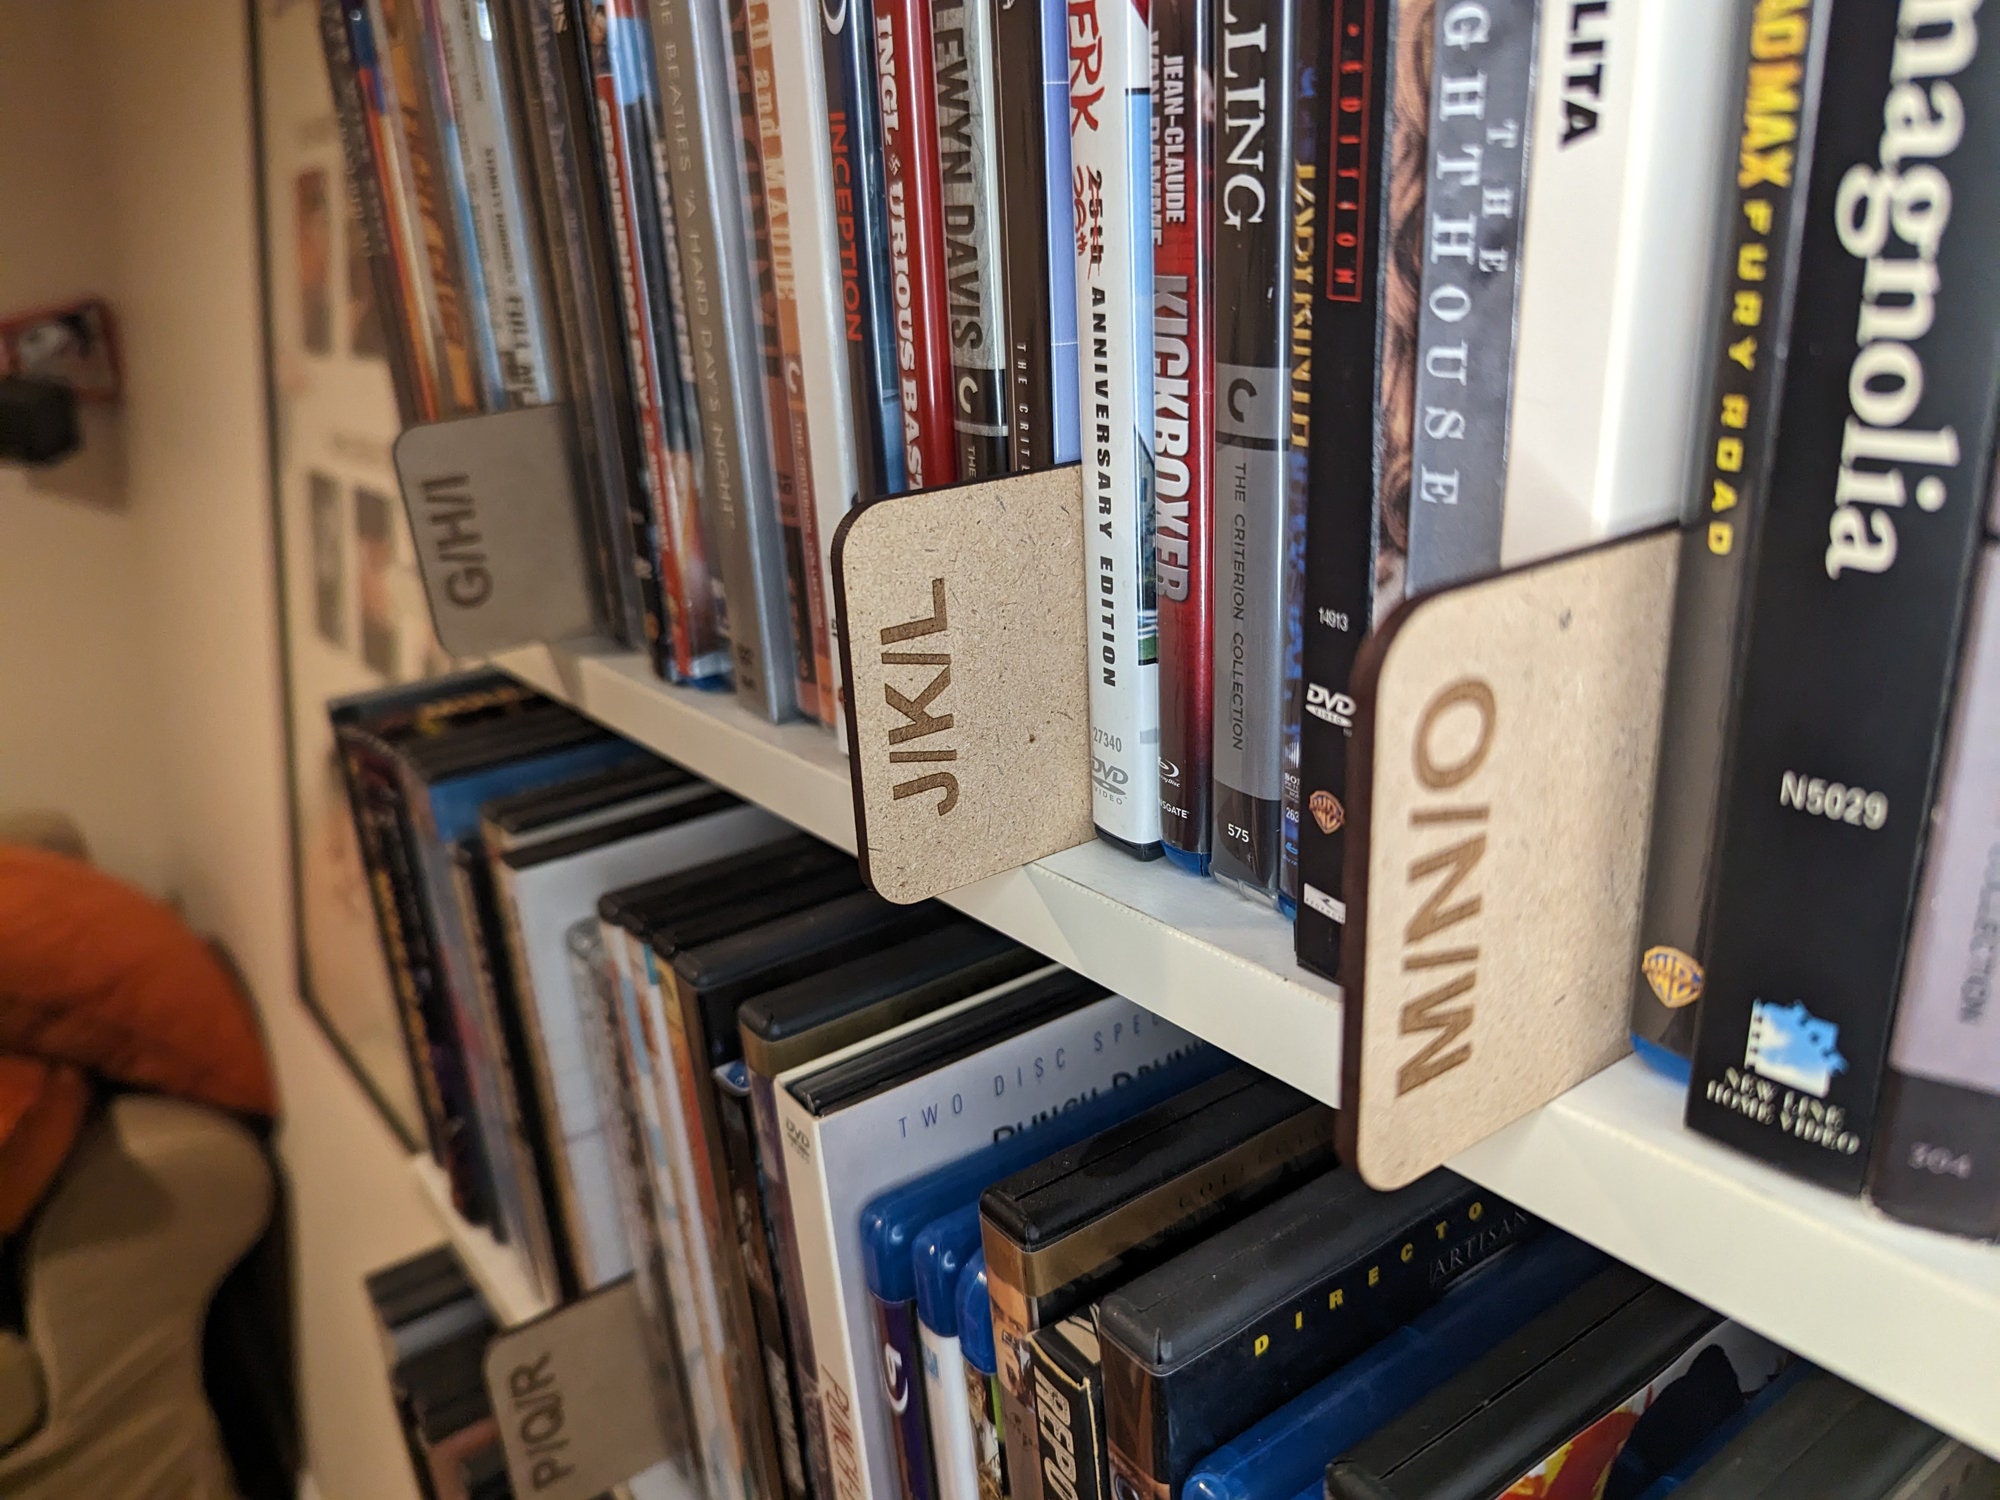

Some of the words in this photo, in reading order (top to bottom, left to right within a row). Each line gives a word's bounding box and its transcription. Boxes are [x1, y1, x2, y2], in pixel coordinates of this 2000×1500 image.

[755, 69, 780, 137] and
[1163, 54, 1185, 224] JEAN-CLAUDE
[664, 40, 691, 173] BEATLES
[688, 233, 708, 316] HARD
[700, 330, 721, 413] DAY'S
[766, 157, 797, 300] MAUDE
[829, 111, 863, 342] INCEPTION
[945, 203, 984, 351] DAVIS
[1728, 200, 1773, 371] FURY
[1017, 342, 1029, 385] THE
[1090, 286, 1113, 540] ANNIVERSARY
[1152, 274, 1190, 602] KICKBOXER
[967, 445, 977, 478] THE
[1233, 462, 1247, 503] THE
[1707, 394, 1749, 555] ROAD
[1233, 513, 1247, 621] CRITERION
[1100, 556, 1116, 687] EDITION
[1318, 606, 1349, 632] 14913
[1231, 632, 1245, 752] COLLECTION
[1306, 682, 1357, 717] DVD
[1092, 755, 1129, 785] DVD
[1093, 726, 1122, 753] 27340
[1094, 786, 1124, 806] VIDEO
[1227, 823, 1250, 843] 575
[1780, 769, 1888, 831] N5029
[899, 1093, 965, 1138] TWO
[993, 1047, 1067, 1097] DISC
[1706, 1079, 1776, 1126] HOME
[1779, 1108, 1860, 1155] VIDEO
[1725, 1066, 1776, 1104] NEW
[1783, 1090, 1846, 1134] LINE
[785, 1117, 811, 1149] DVD
